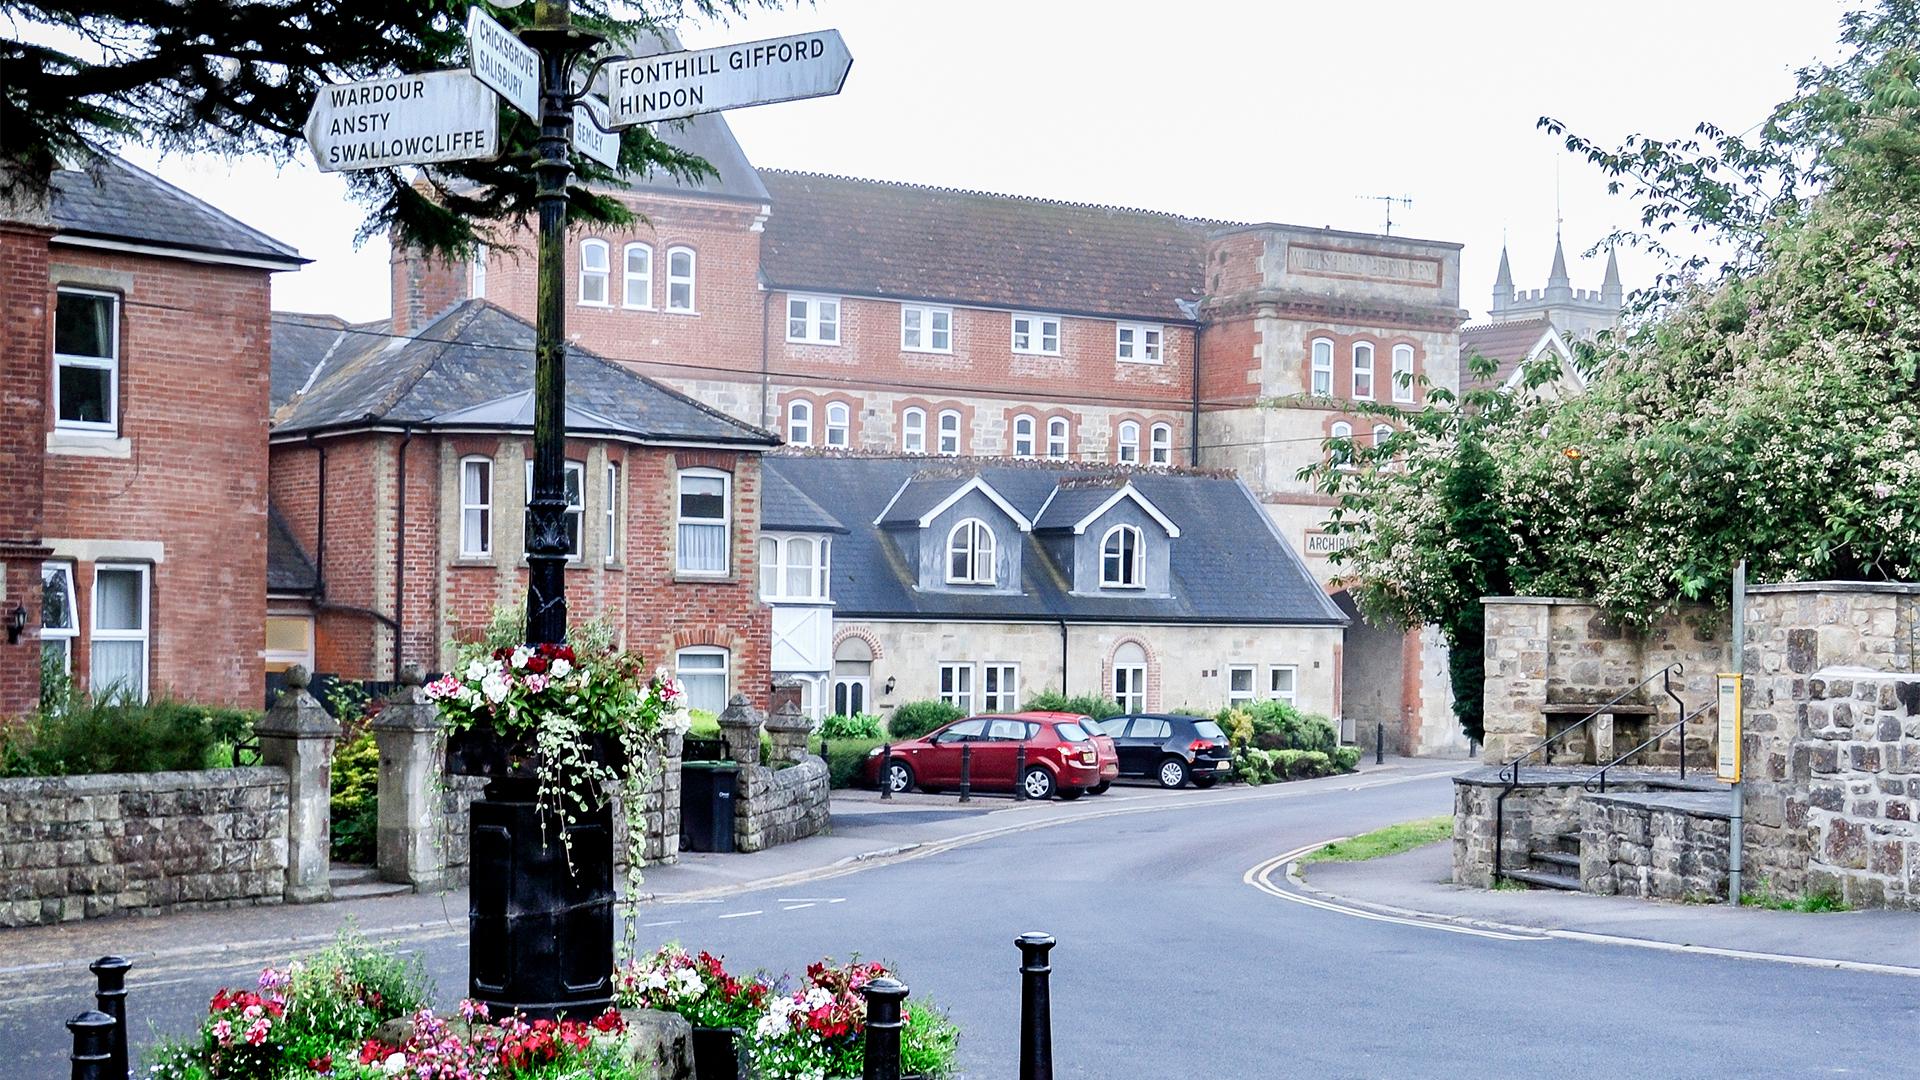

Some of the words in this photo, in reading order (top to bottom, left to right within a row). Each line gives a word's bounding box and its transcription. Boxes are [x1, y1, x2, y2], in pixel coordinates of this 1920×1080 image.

[479, 19, 534, 78] CHICKSGROVE
[619, 55, 720, 88] FONTHILL
[729, 39, 824, 70] GIFFORD
[479, 50, 523, 99] SALISBURY
[331, 81, 424, 108] WARDOUR
[620, 86, 704, 116] HINDON
[330, 112, 391, 136] ANSTY
[577, 122, 604, 153] SEMLEY
[329, 130, 485, 163] SWALLOWCLIFFE
